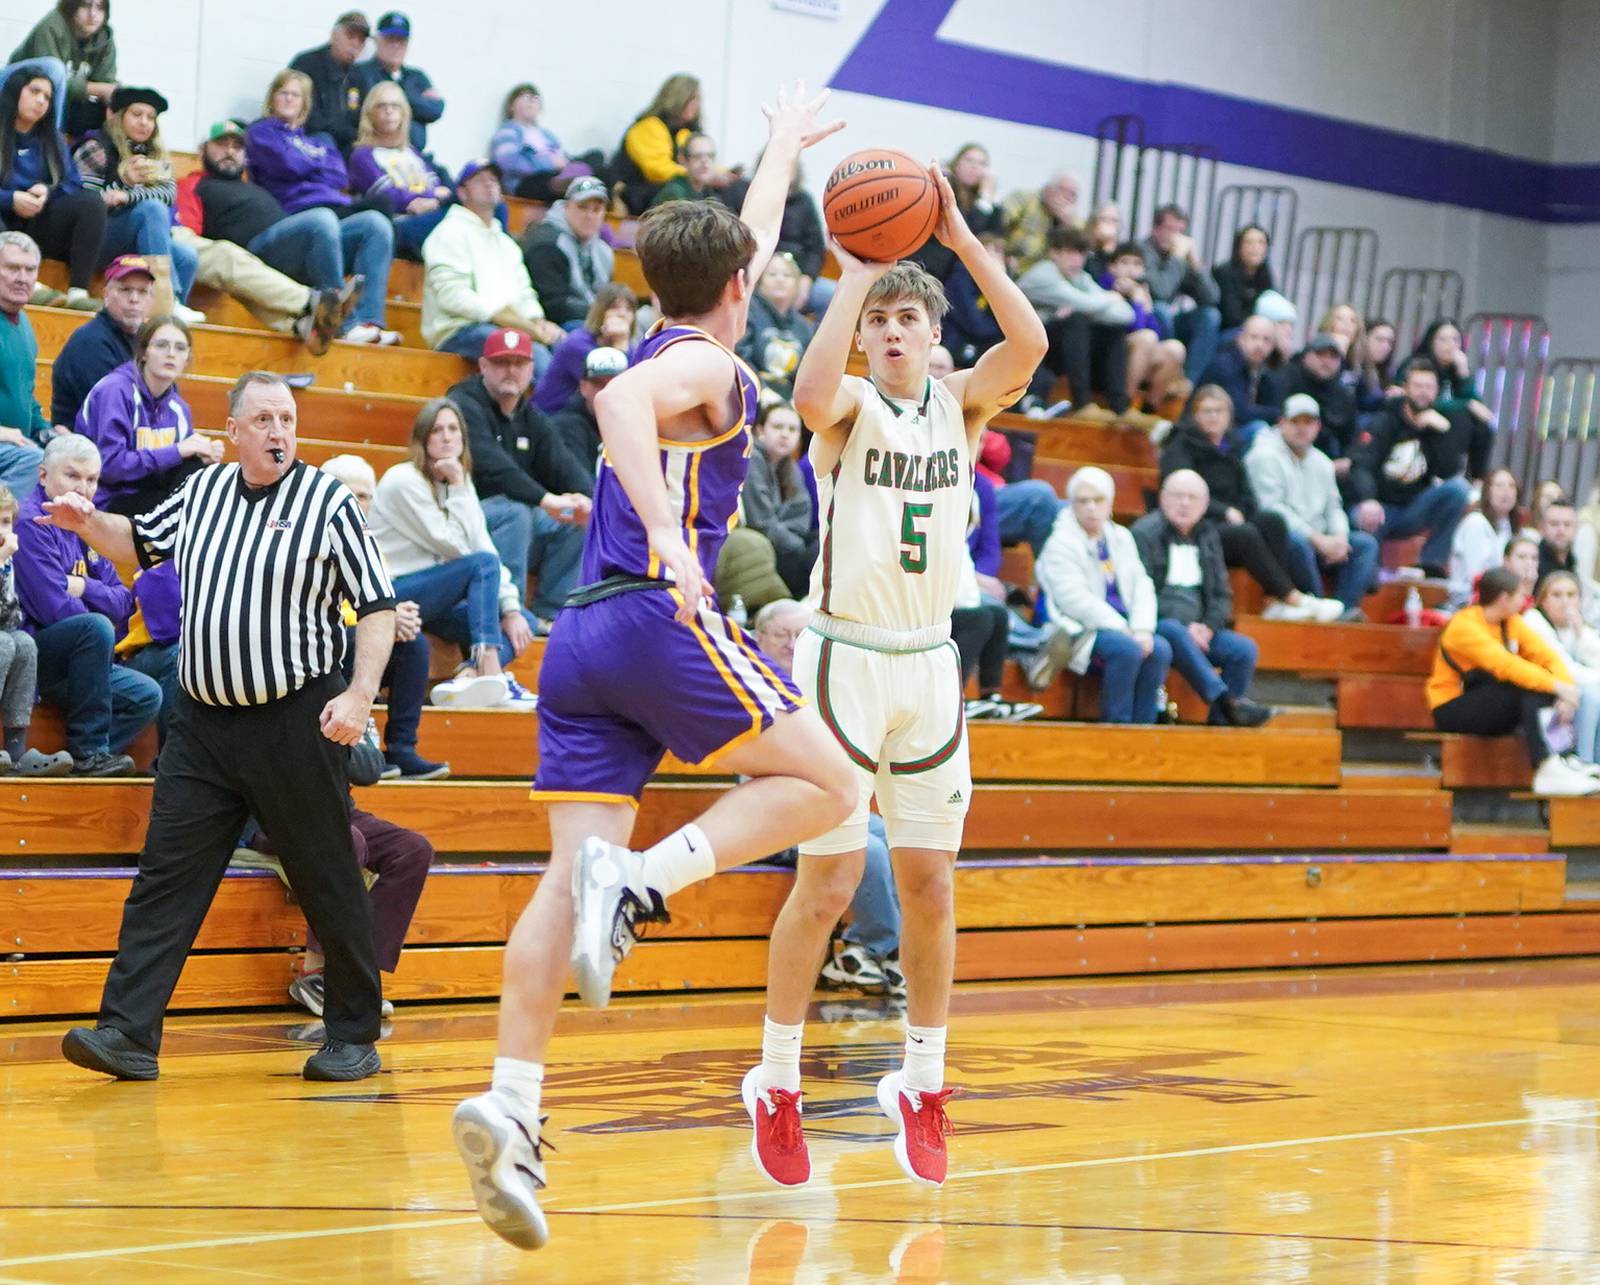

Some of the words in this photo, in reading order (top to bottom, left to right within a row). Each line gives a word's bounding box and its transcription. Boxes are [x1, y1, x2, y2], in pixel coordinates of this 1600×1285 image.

[825, 160, 896, 193] Wilson
[834, 187, 899, 221] EVOLUTION
[863, 448, 959, 492] CAVALIERS
[899, 501, 933, 574] 5
